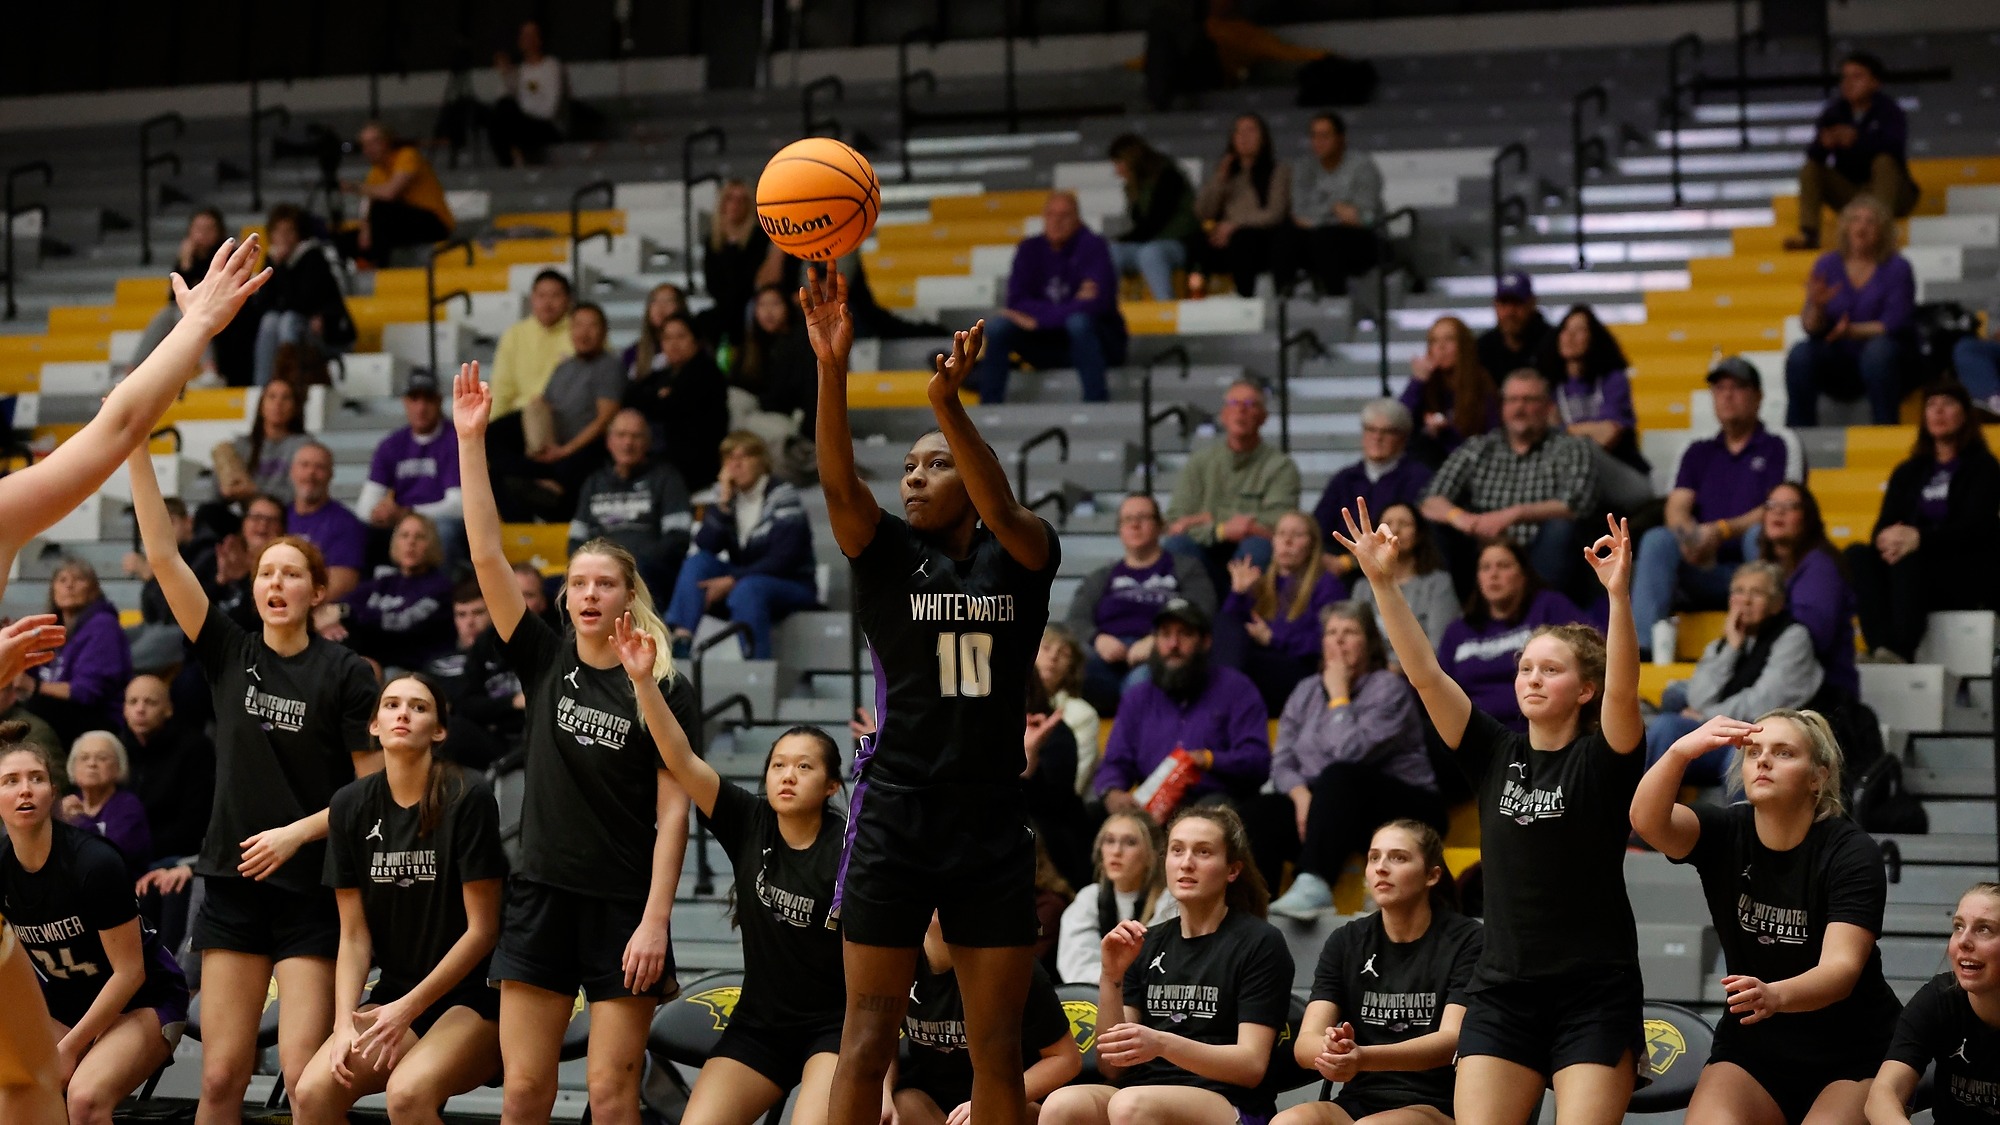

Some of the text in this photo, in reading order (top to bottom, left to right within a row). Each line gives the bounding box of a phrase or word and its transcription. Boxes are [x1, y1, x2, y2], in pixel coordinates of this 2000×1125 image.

[760, 213, 833, 236] Wilson
[910, 593, 1014, 621] WHITEWATER
[936, 632, 993, 697] 10
[372, 850, 436, 867] UW-WHITEWATE
[370, 865, 437, 877] BASKETBAL
[1147, 984, 1219, 1002] UW-WHITEWATER
[1146, 999, 1218, 1012] BASKETBALL
